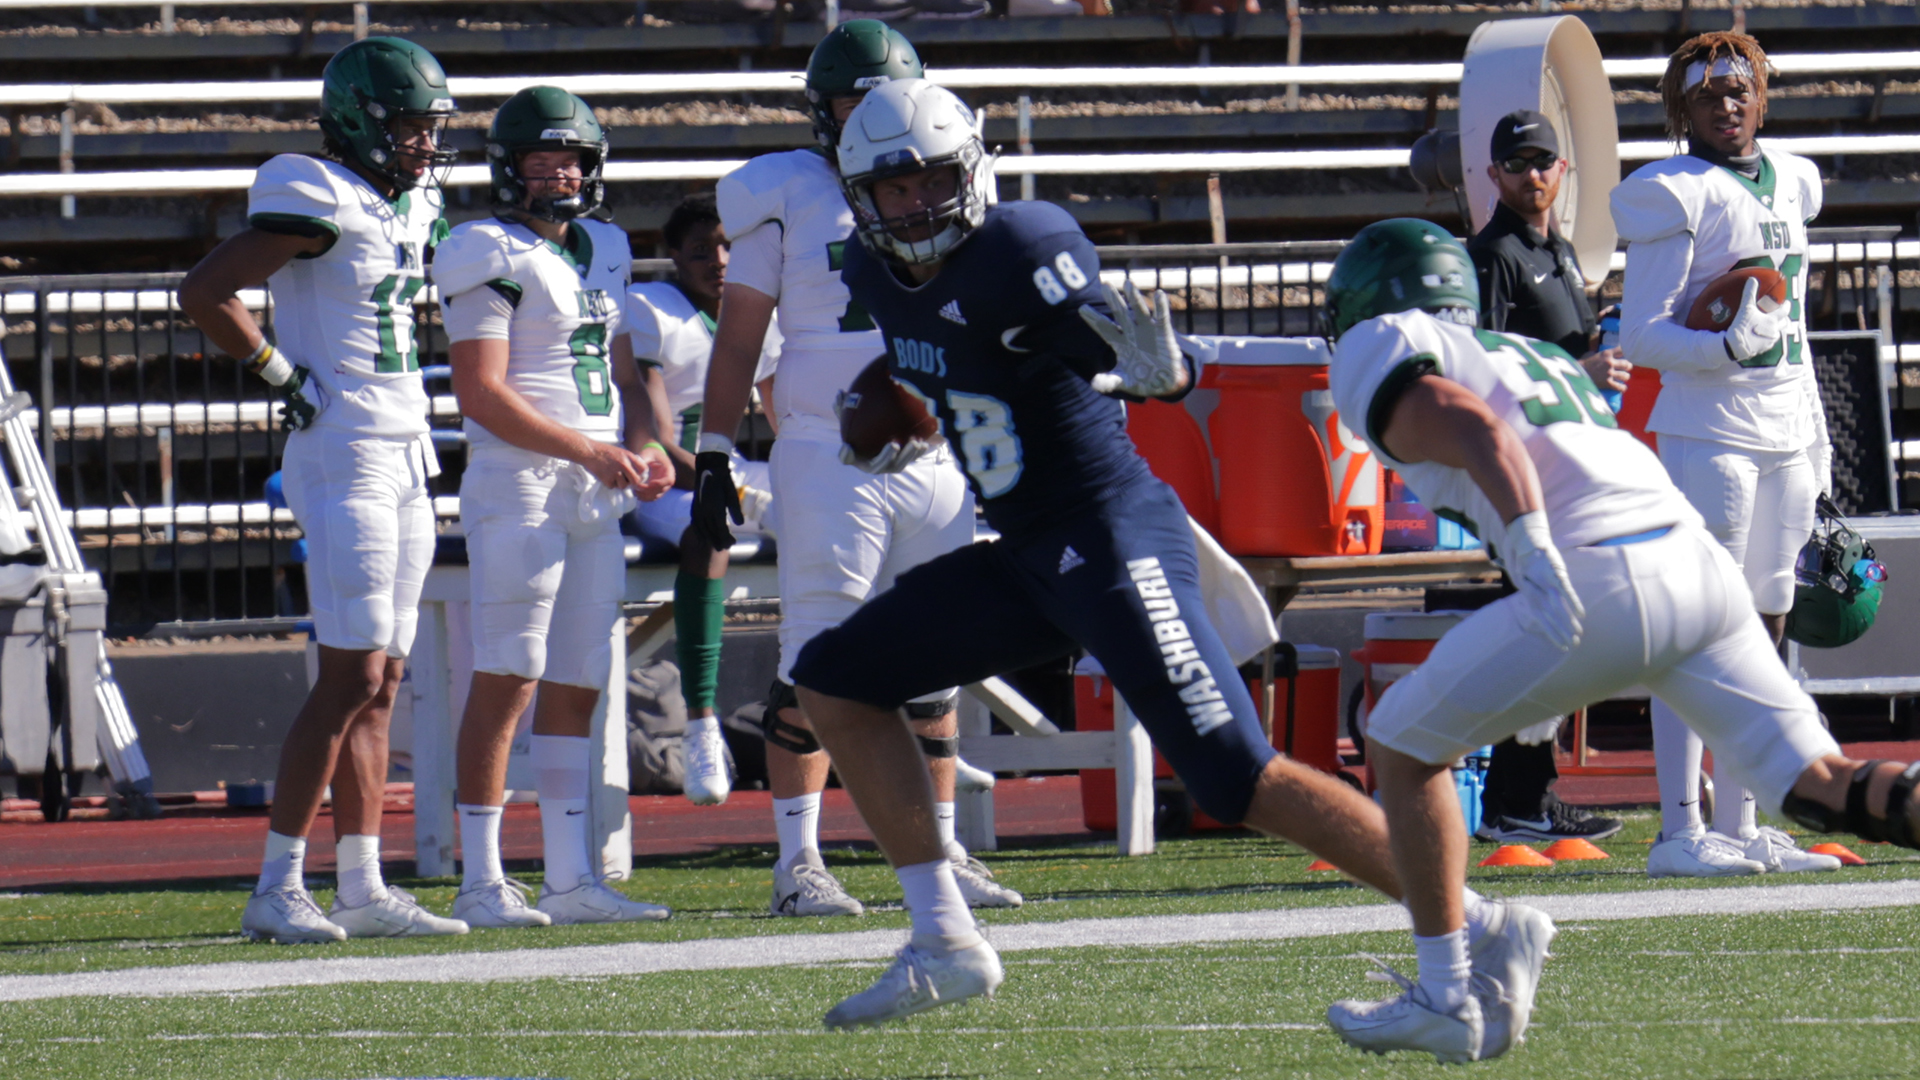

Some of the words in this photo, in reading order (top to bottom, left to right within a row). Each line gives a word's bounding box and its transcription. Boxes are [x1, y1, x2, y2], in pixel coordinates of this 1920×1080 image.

[1032, 250, 1088, 306] 88
[567, 322, 615, 416] 8
[893, 336, 947, 378] BODS
[1474, 327, 1618, 428] 32
[1385, 519, 1428, 531] ERADE
[1126, 556, 1233, 736] WASHBURN
